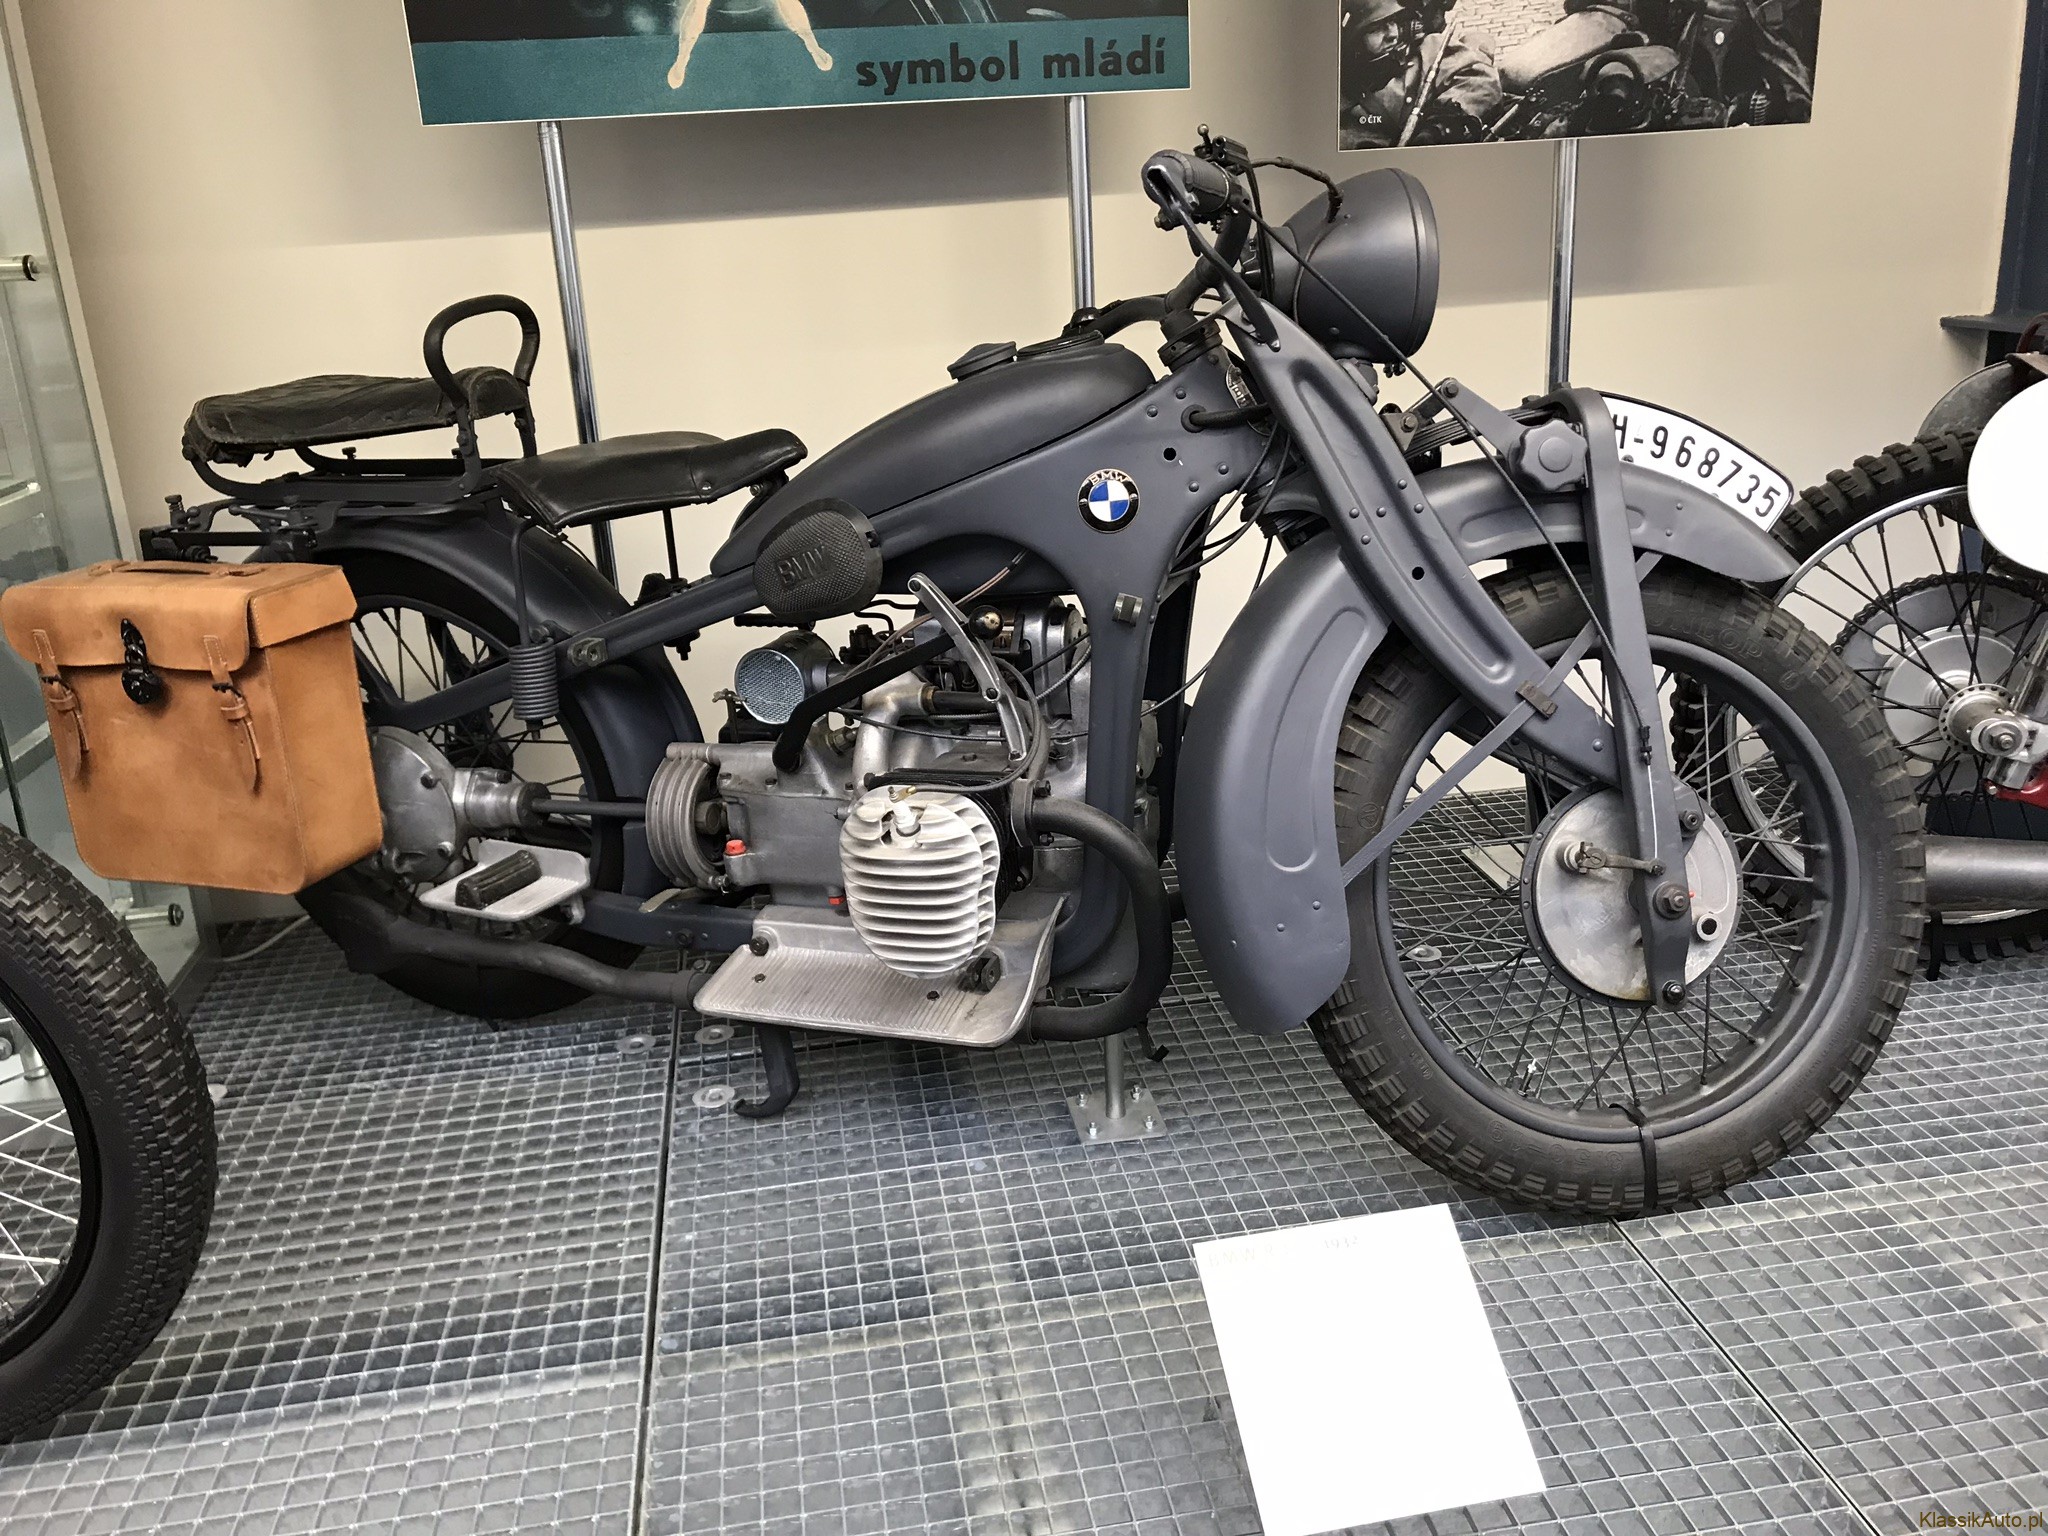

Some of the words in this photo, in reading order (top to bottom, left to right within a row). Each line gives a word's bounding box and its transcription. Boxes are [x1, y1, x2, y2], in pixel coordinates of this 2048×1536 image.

[856, 40, 1019, 96] symbol
[1043, 34, 1166, 79] mládí
[1367, 114, 1382, 124] ČTK
[1088, 470, 1128, 486] BMW
[1612, 413, 1781, 518] H-968735
[779, 544, 829, 585] BMW
[1645, 605, 1763, 659] UNLOP
